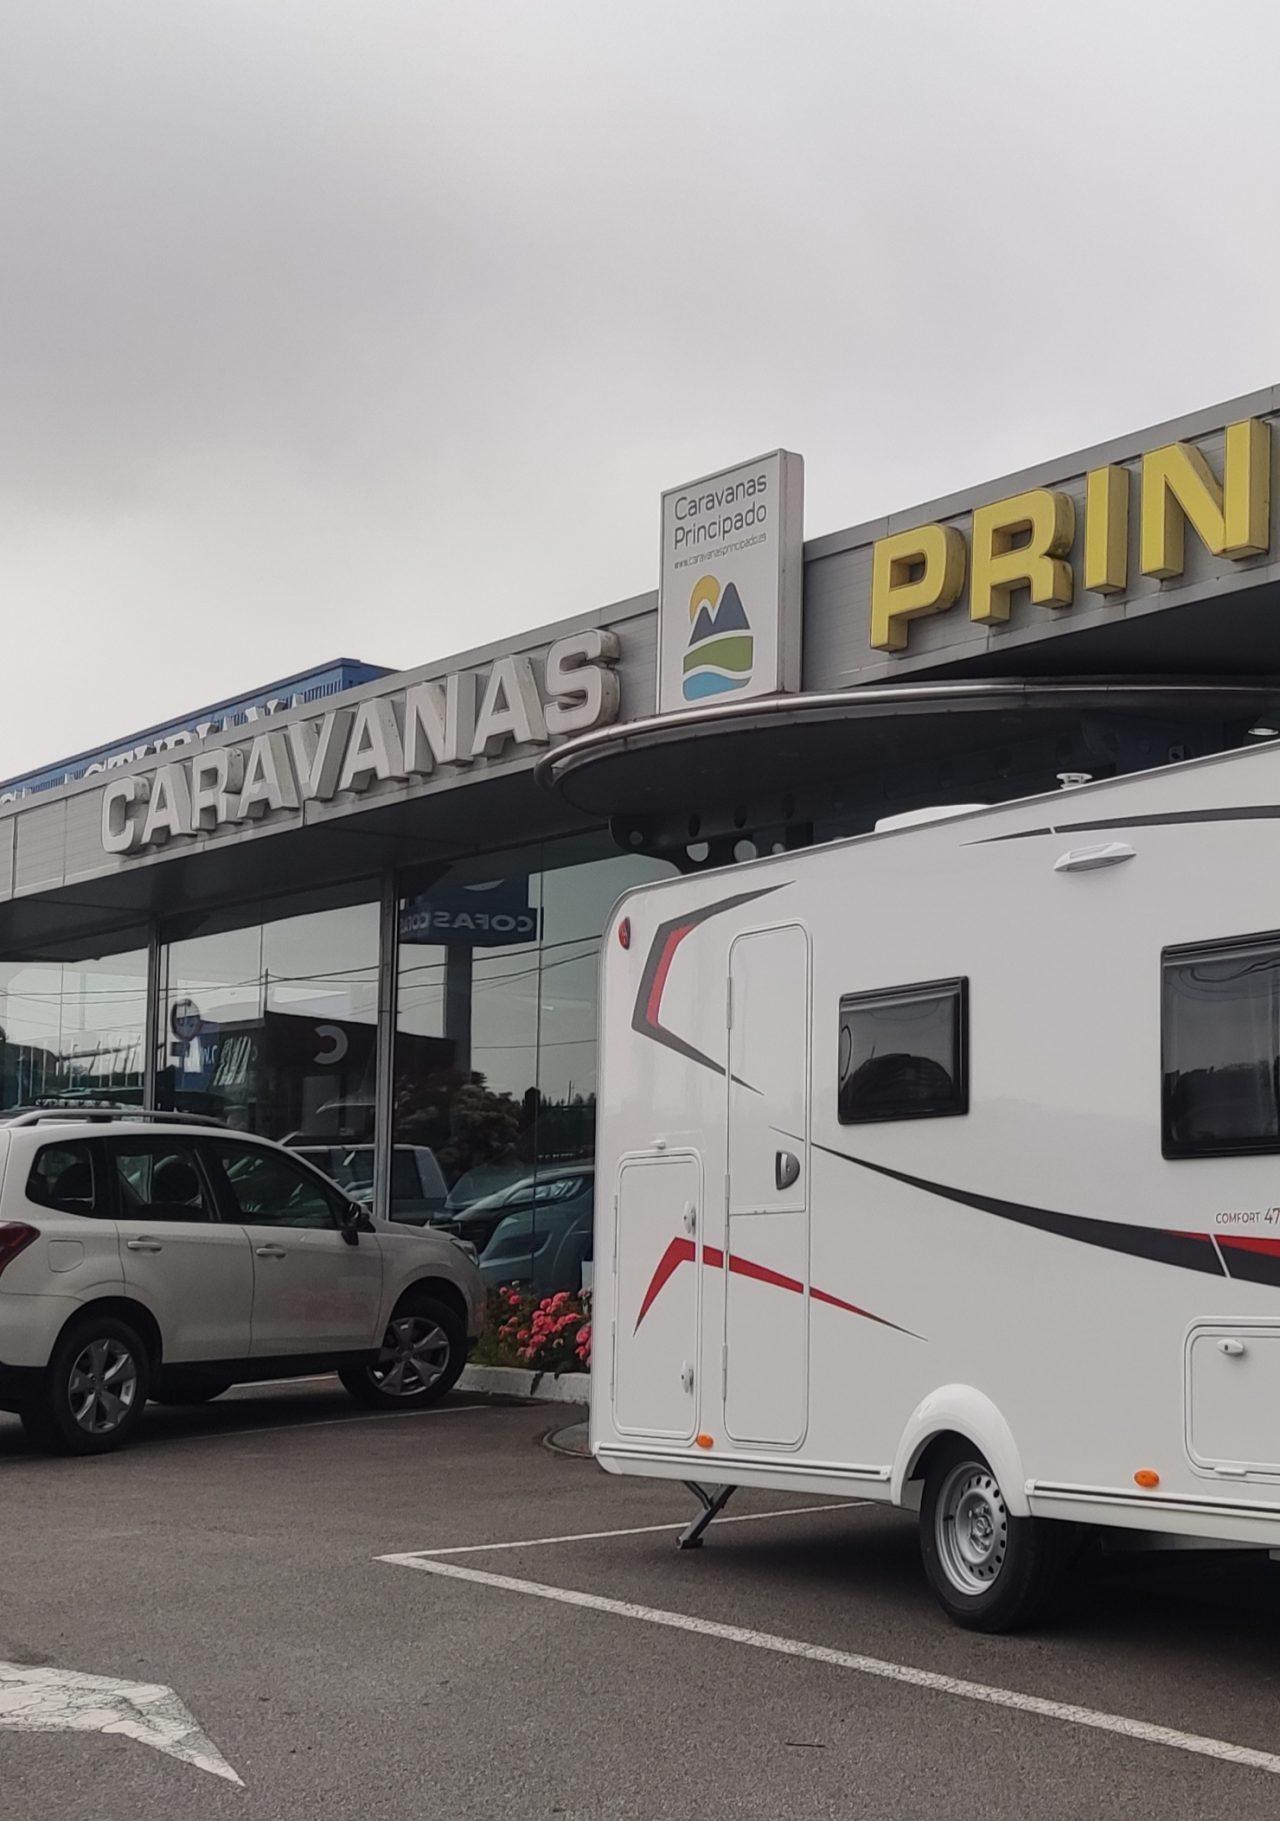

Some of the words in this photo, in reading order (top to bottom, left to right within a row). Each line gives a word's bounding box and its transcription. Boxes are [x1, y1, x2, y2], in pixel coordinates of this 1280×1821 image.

[674, 473, 767, 521] Caravanas
[674, 501, 767, 550] Principado
[102, 628, 620, 855] CARAVANAS
[1215, 1212, 1261, 1224] COMFORT
